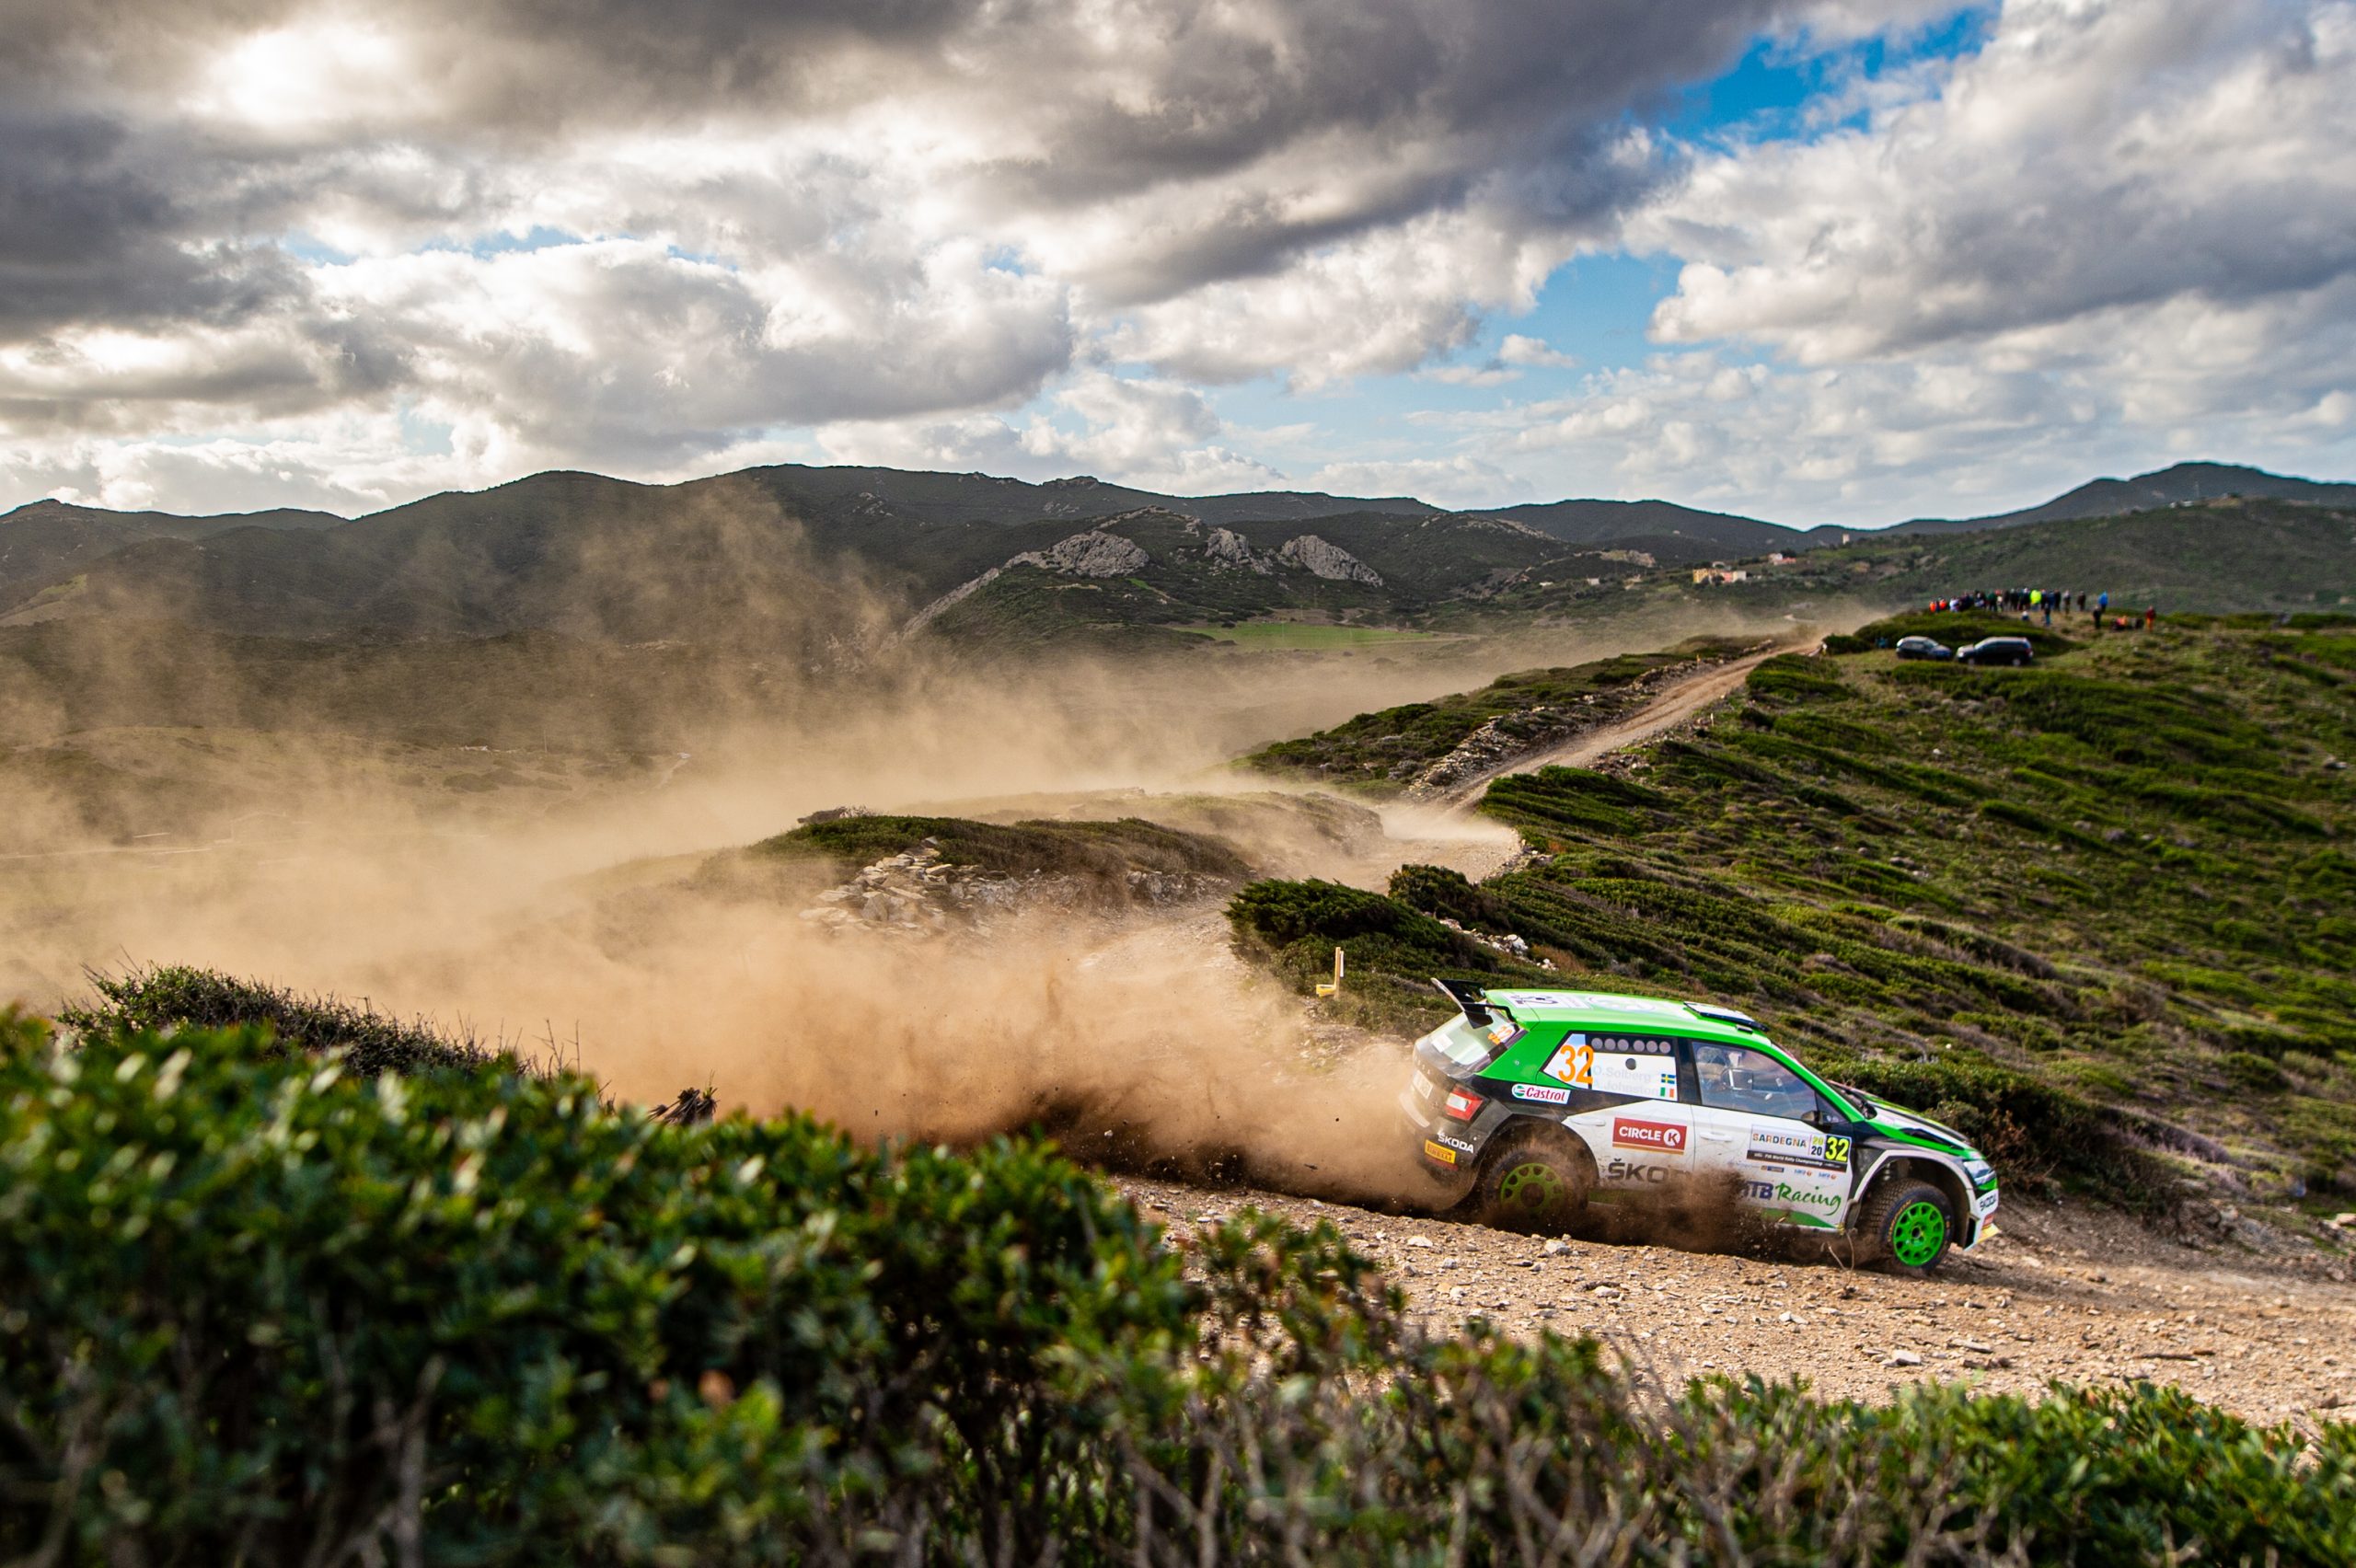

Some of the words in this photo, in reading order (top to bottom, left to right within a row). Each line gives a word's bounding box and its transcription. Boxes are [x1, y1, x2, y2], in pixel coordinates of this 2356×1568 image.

[1557, 1044, 1594, 1084] 32
[1526, 1087, 1565, 1101] Castrol
[1619, 1125, 1662, 1141] CIRCLE
[1667, 1131, 1680, 1146] K
[1752, 1133, 1807, 1148] SARDEGNA
[1812, 1136, 1824, 1146] 20
[1811, 1146, 1822, 1156] 20
[1825, 1136, 1850, 1162] 32
[1607, 1158, 1691, 1183] ŠKO
[1774, 1182, 1842, 1216] Racing
